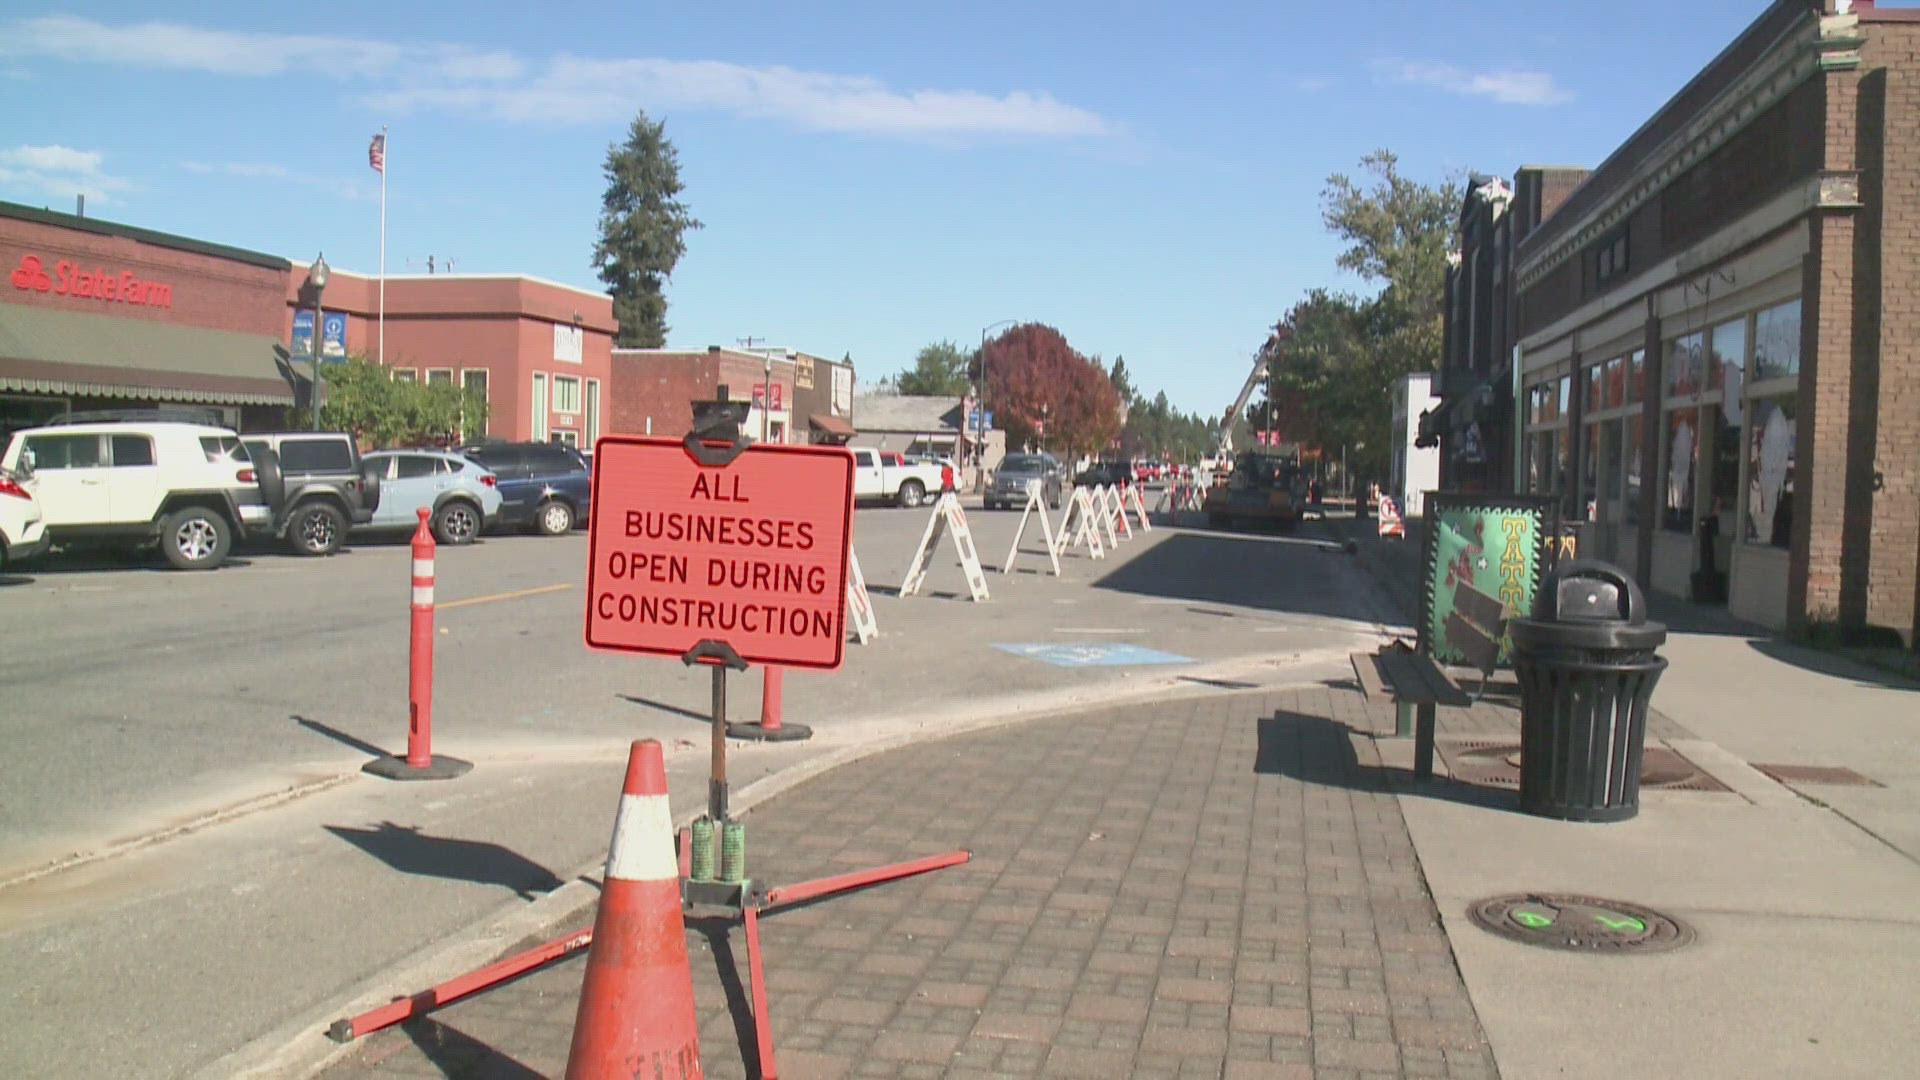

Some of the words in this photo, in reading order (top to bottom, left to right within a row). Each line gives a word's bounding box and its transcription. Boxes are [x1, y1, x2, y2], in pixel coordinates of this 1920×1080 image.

[690, 472, 749, 502] ALL
[625, 510, 814, 550] BUSINESSES
[608, 551, 688, 584] OPEN
[707, 558, 825, 594] DURING
[598, 592, 832, 638] CONSTRUCTION
